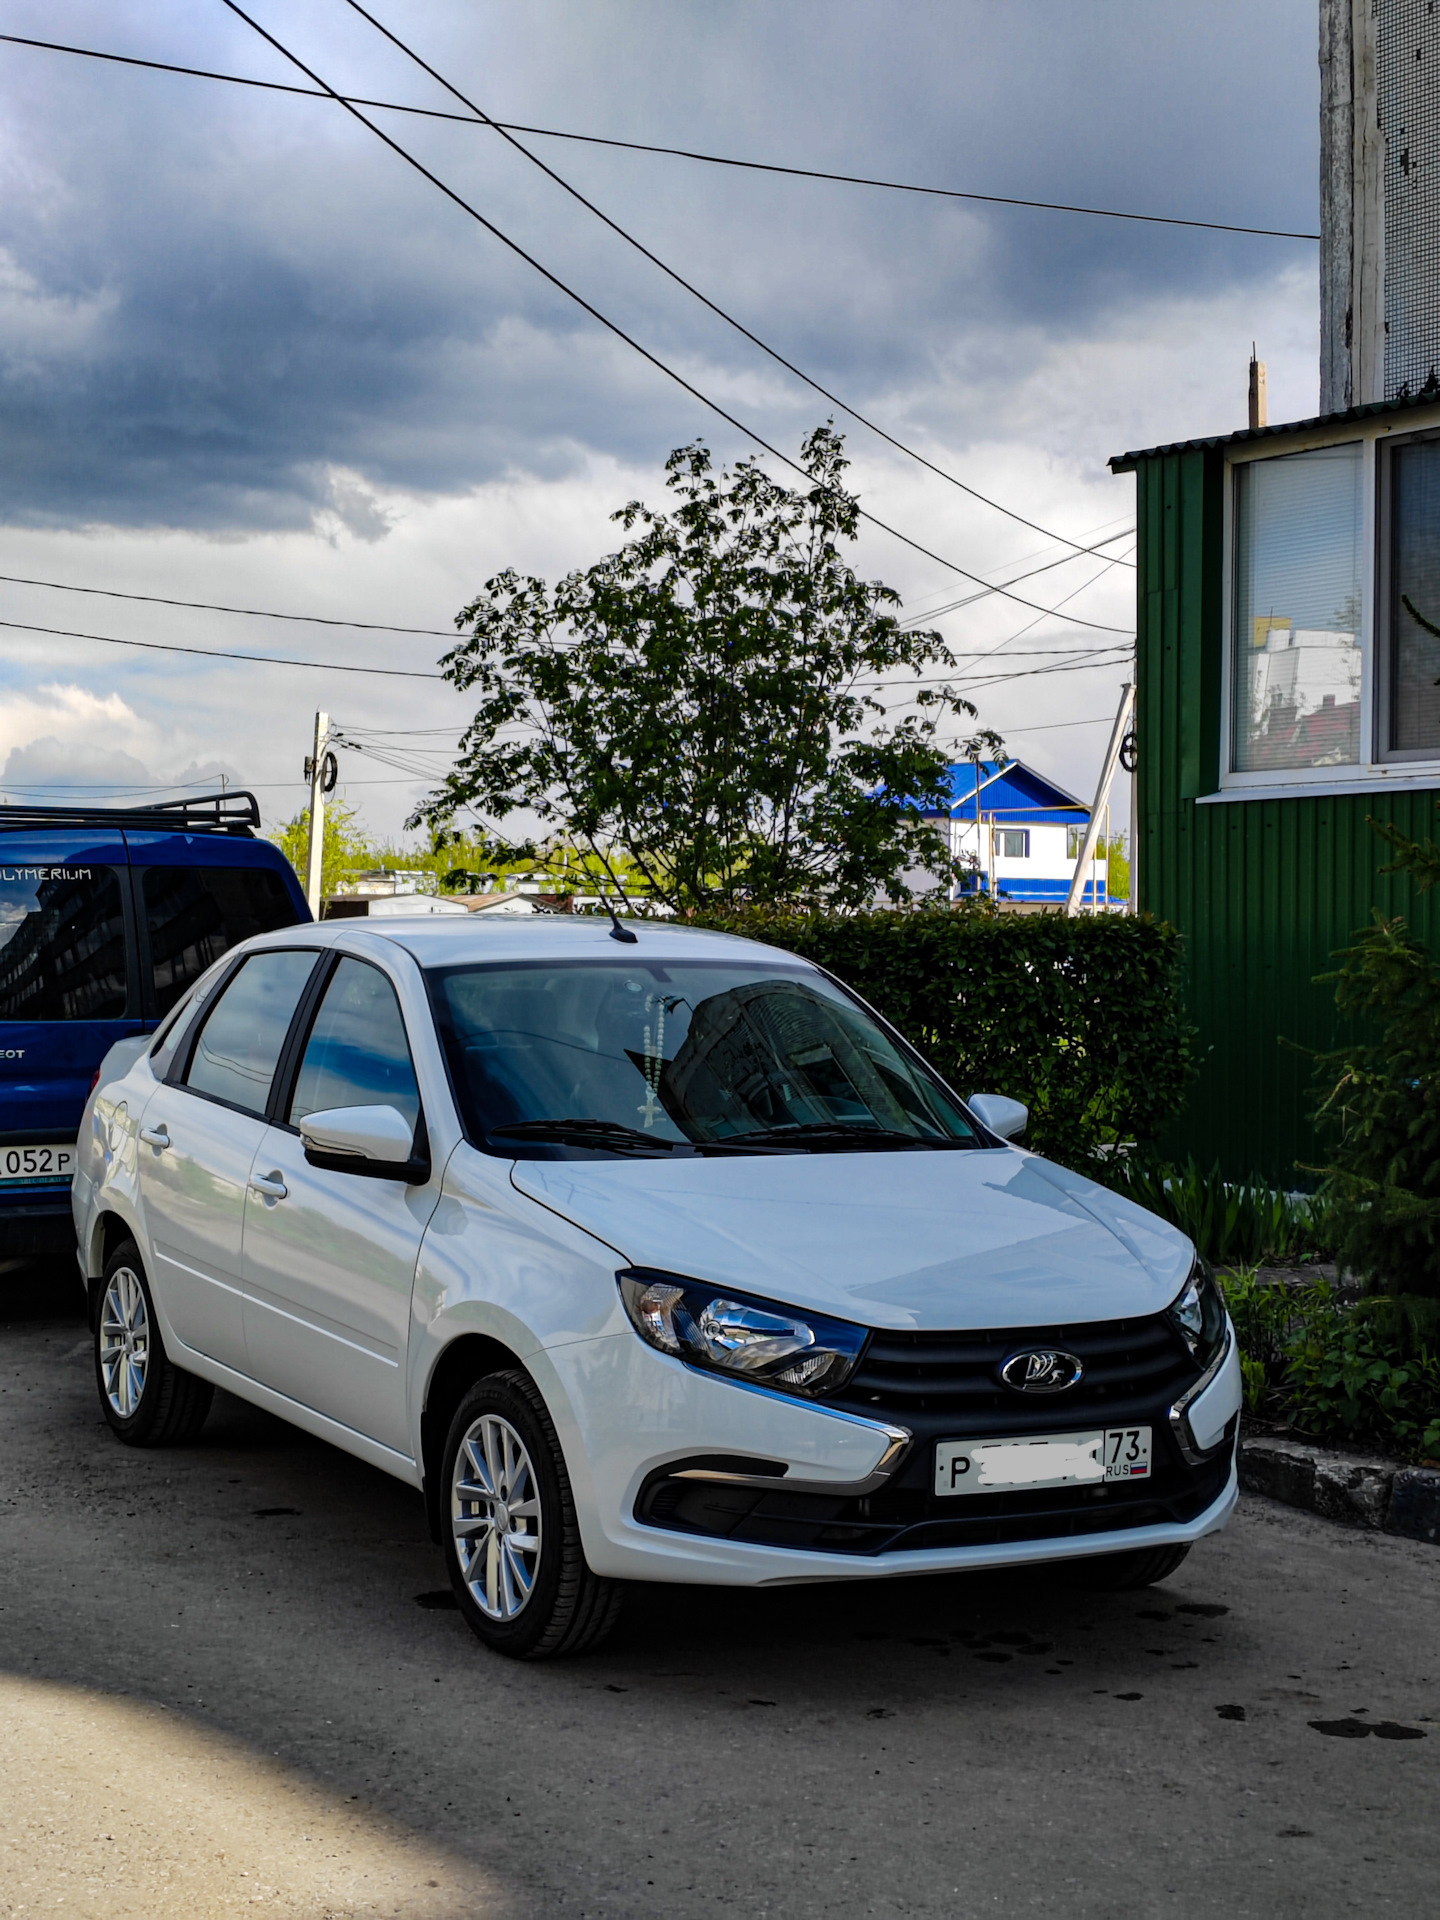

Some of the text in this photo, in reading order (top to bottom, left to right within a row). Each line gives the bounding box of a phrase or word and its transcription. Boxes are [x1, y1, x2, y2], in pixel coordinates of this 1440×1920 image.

[0, 868, 92, 881] LYMERIUM
[0, 1149, 70, 1175] 052P
[1109, 1430, 1140, 1464] 73
[1105, 1464, 1129, 1478] RUS
